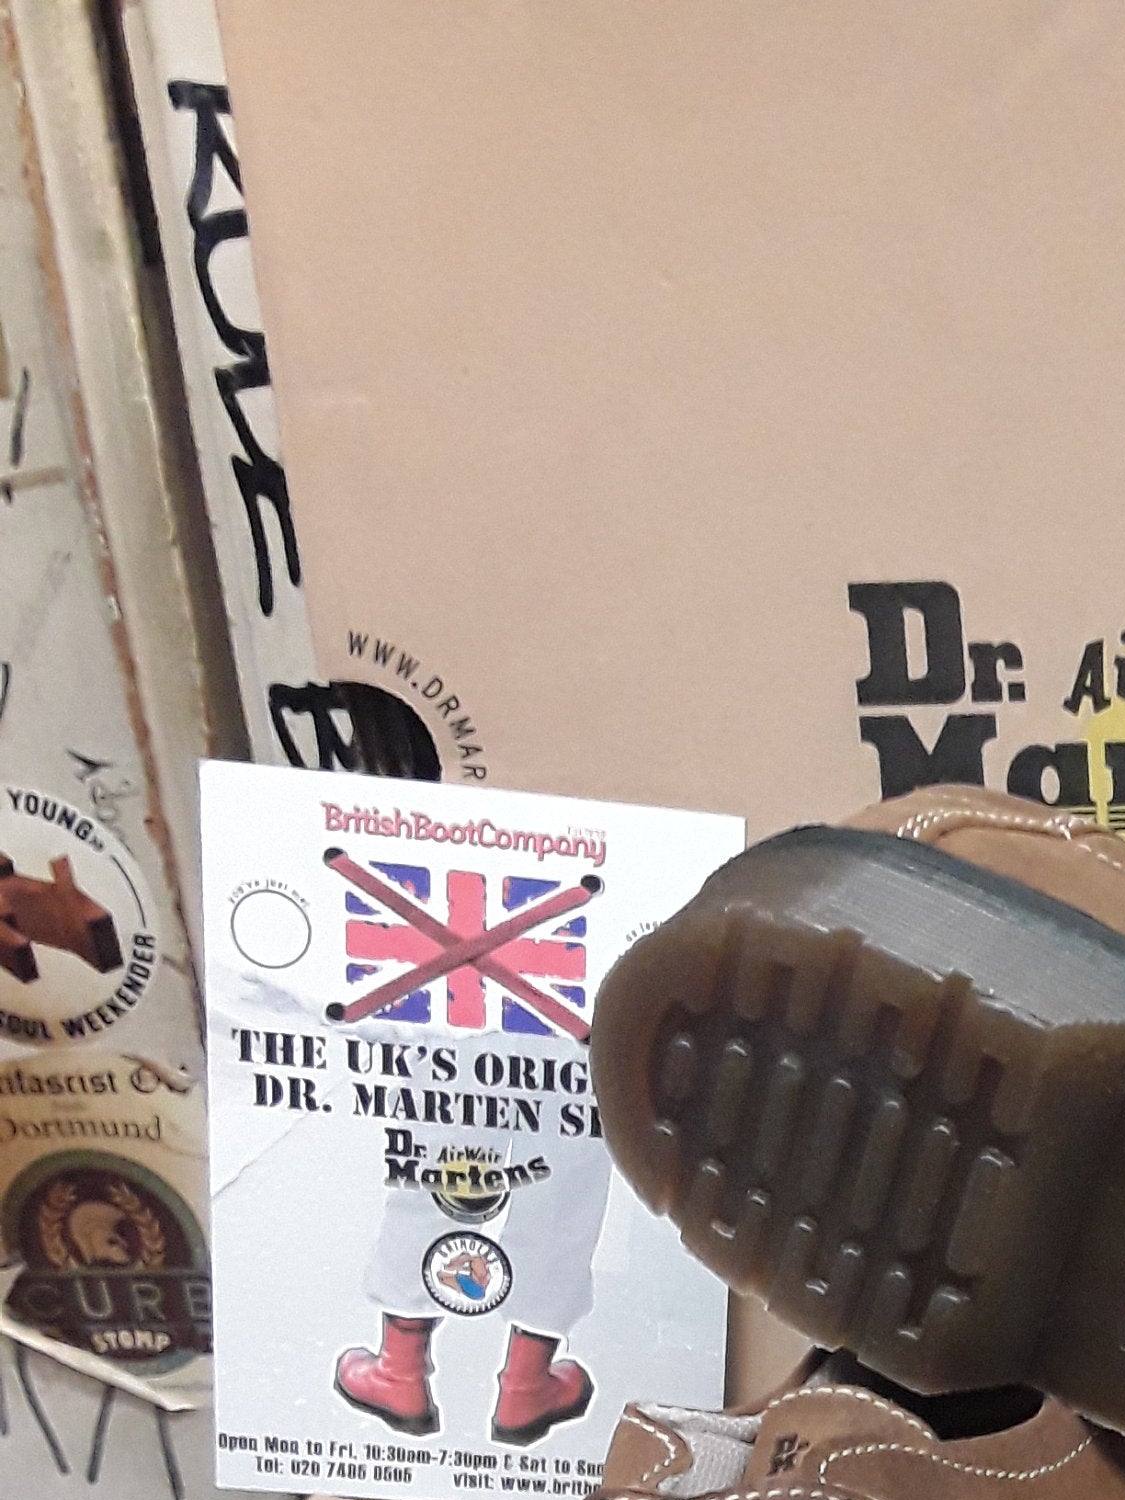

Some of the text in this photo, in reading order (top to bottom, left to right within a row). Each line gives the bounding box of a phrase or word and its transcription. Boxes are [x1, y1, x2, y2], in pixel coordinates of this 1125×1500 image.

[848, 580, 1026, 706] Dr.
[321, 803, 606, 867] BritishBootCompany
[231, 1028, 597, 1095] THE UK'S ORIG
[253, 1072, 333, 1114] DR.
[351, 1082, 542, 1133] MARTEN
[384, 1127, 427, 1158] Dr.
[384, 1155, 552, 1193] Martens
[264, 1436, 300, 1455] Mon
[306, 1440, 323, 1456] to
[519, 1454, 548, 1473] Sat
[554, 1458, 571, 1474] to
